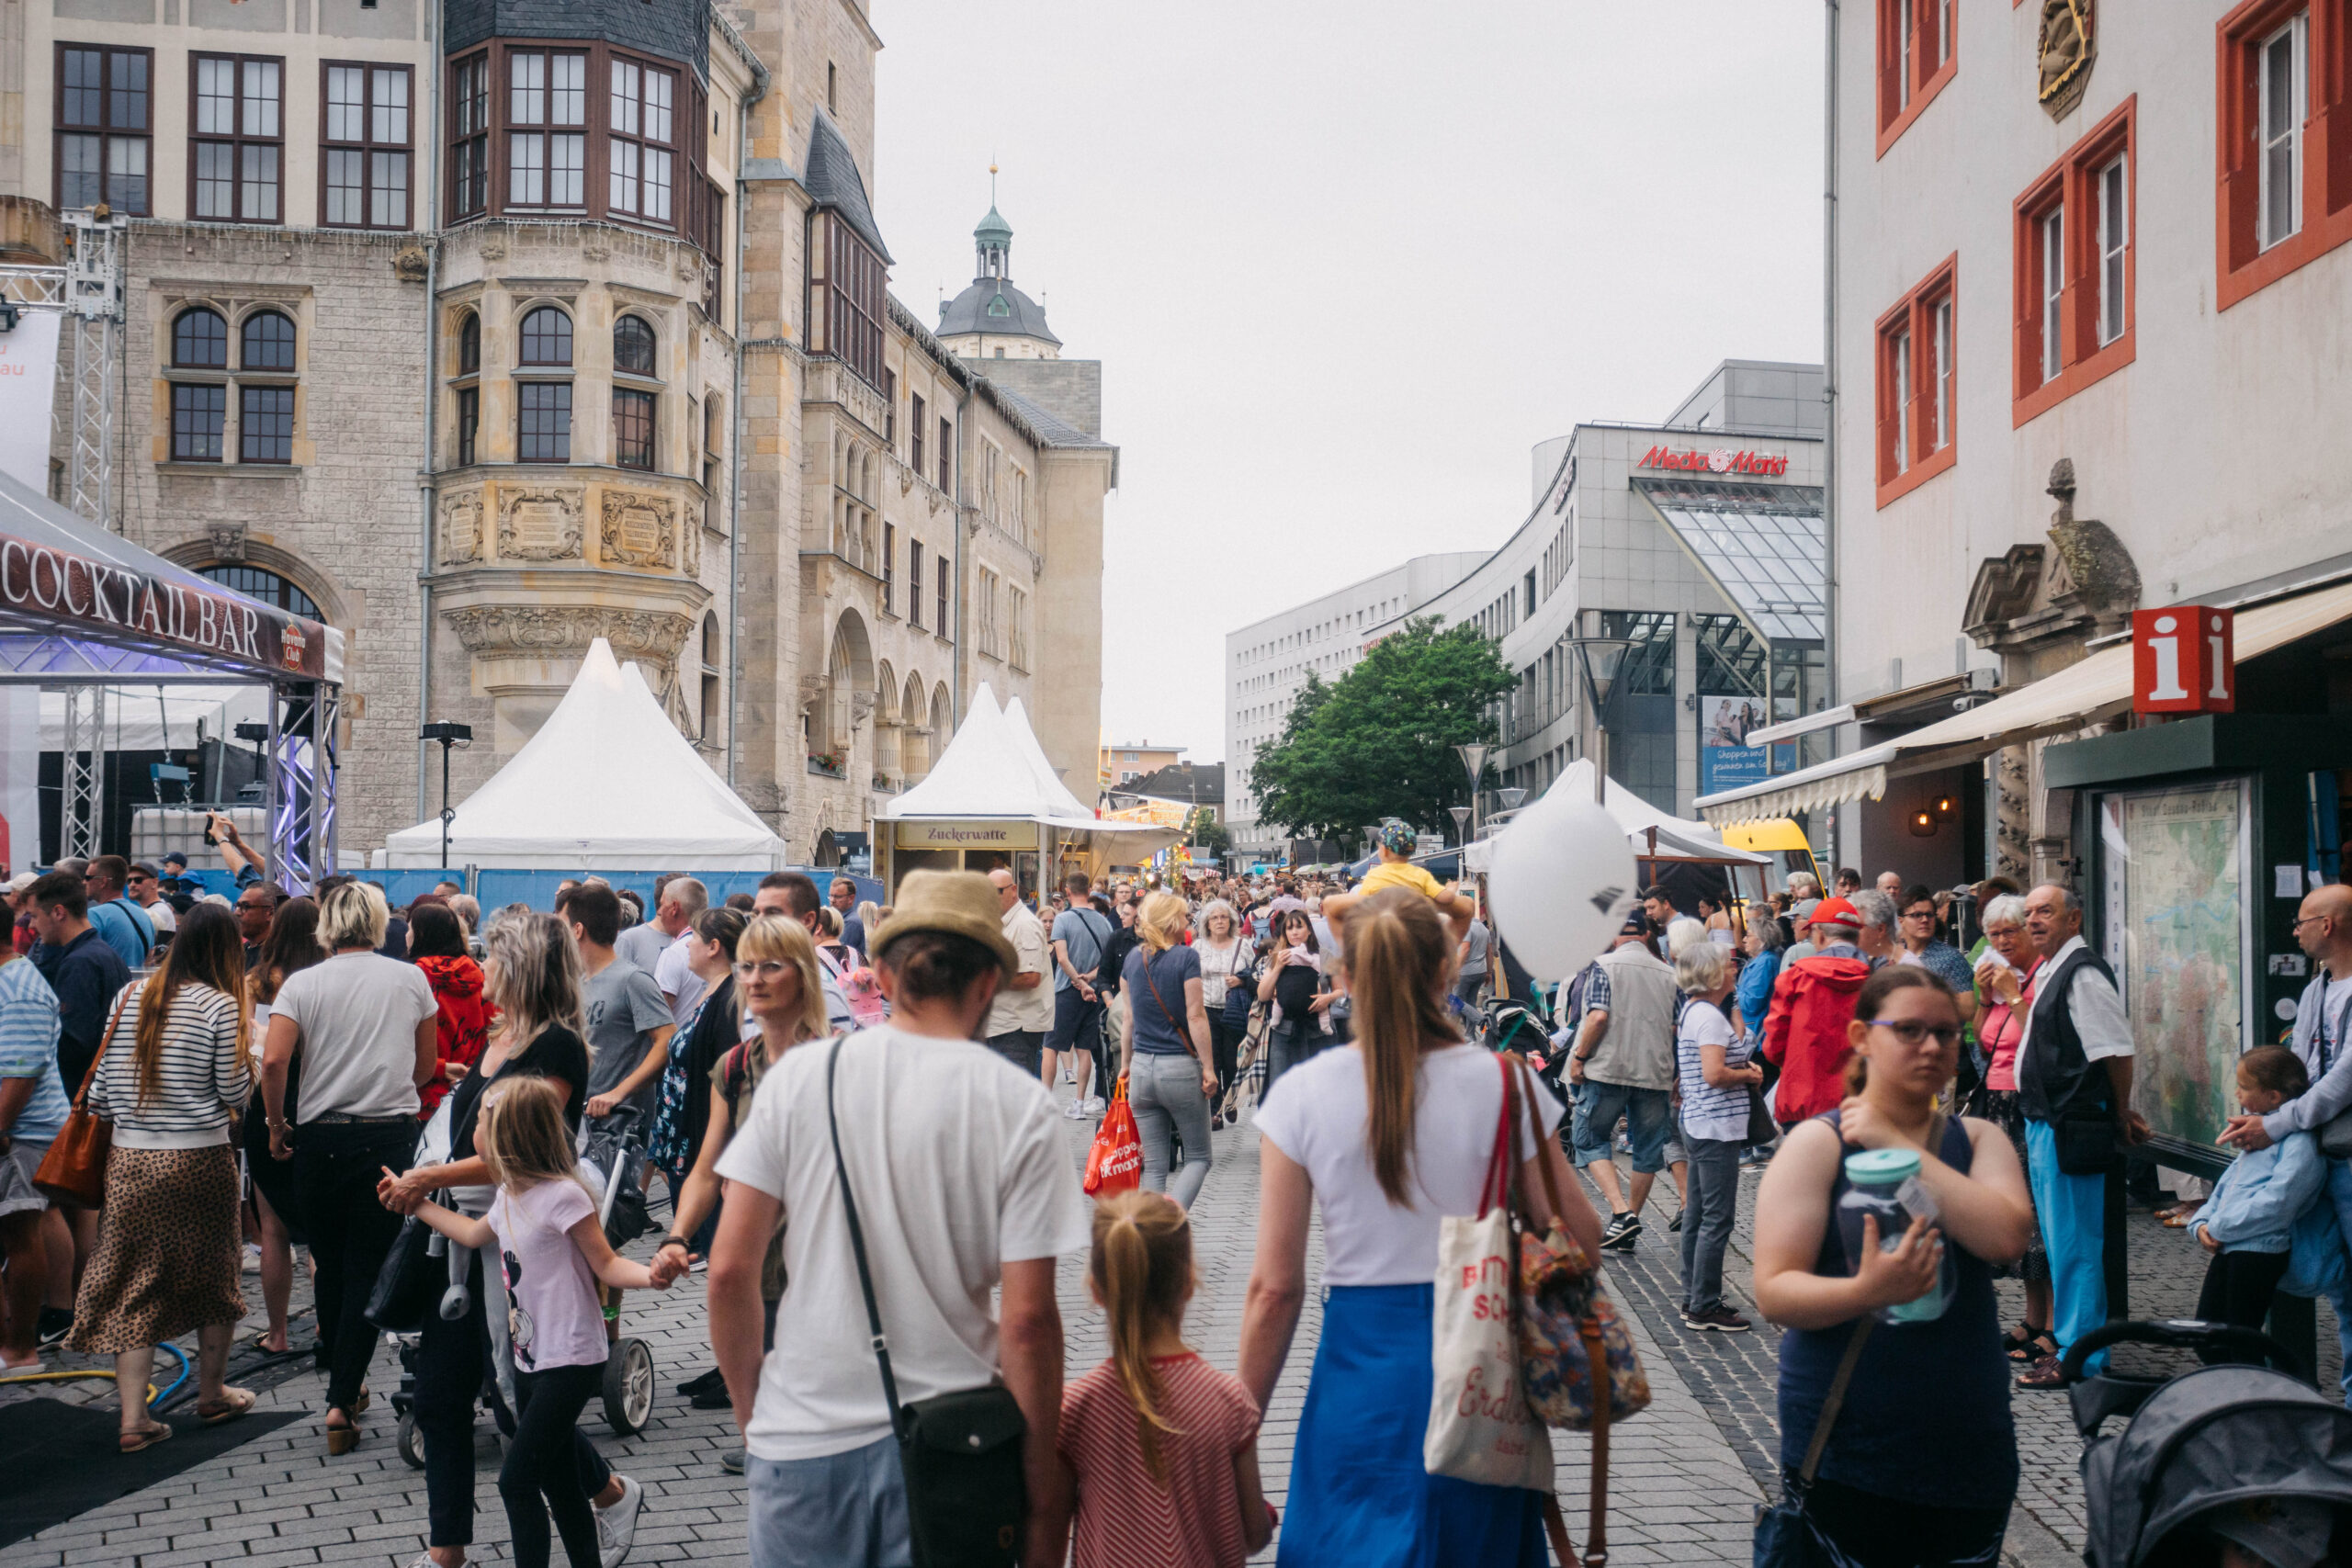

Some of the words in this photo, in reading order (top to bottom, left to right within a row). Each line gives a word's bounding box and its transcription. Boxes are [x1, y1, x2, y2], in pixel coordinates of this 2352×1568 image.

[1636, 446, 1709, 471] Media
[1726, 450, 1789, 475] Markt
[2, 540, 263, 660] COCKTAILBAR
[281, 629, 306, 649] Havana
[286, 647, 300, 662] Club
[927, 828, 1007, 842] Zuckerwatte
